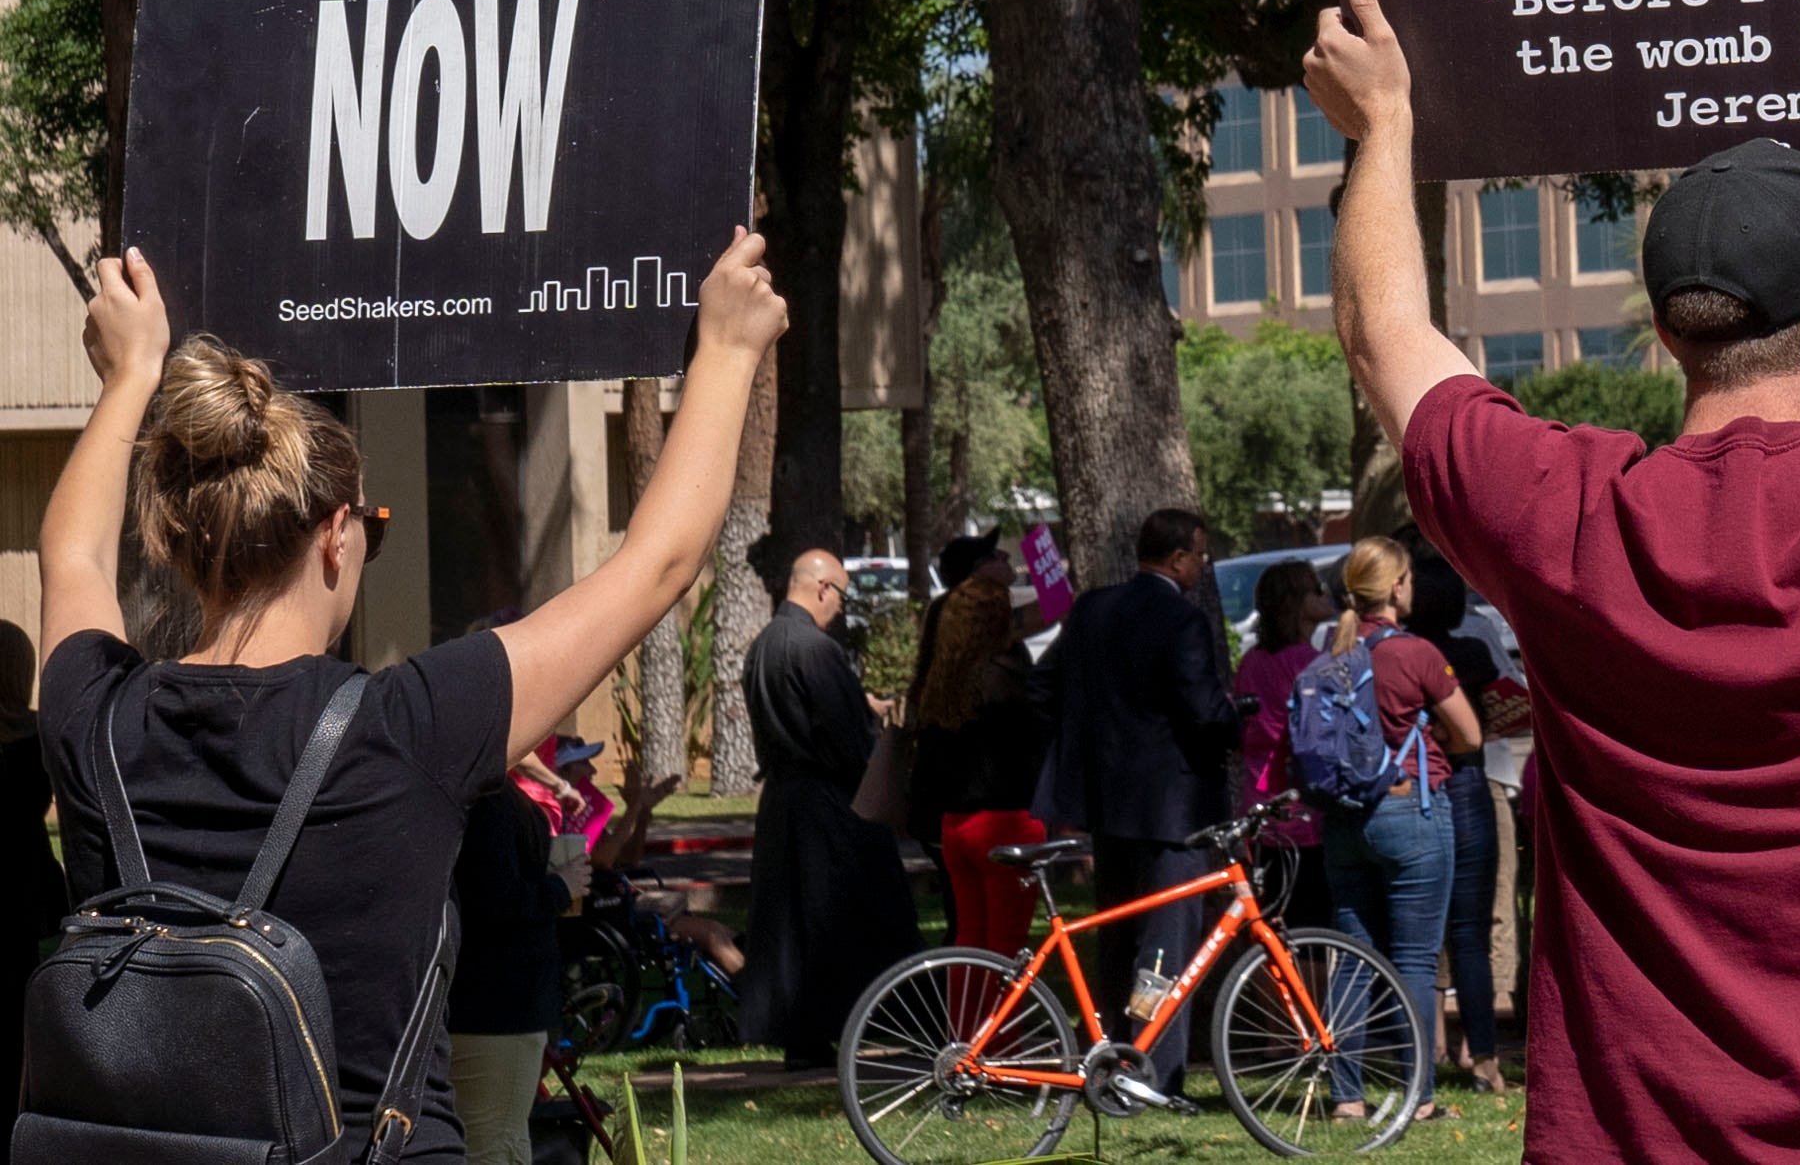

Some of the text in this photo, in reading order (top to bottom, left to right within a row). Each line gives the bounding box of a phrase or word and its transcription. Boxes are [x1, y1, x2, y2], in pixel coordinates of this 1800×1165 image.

[1516, 36, 1613, 76] the
[1636, 26, 1772, 70] womb
[278, 296, 492, 321] SeedShakers.com
[1171, 926, 1226, 1000] TREK
